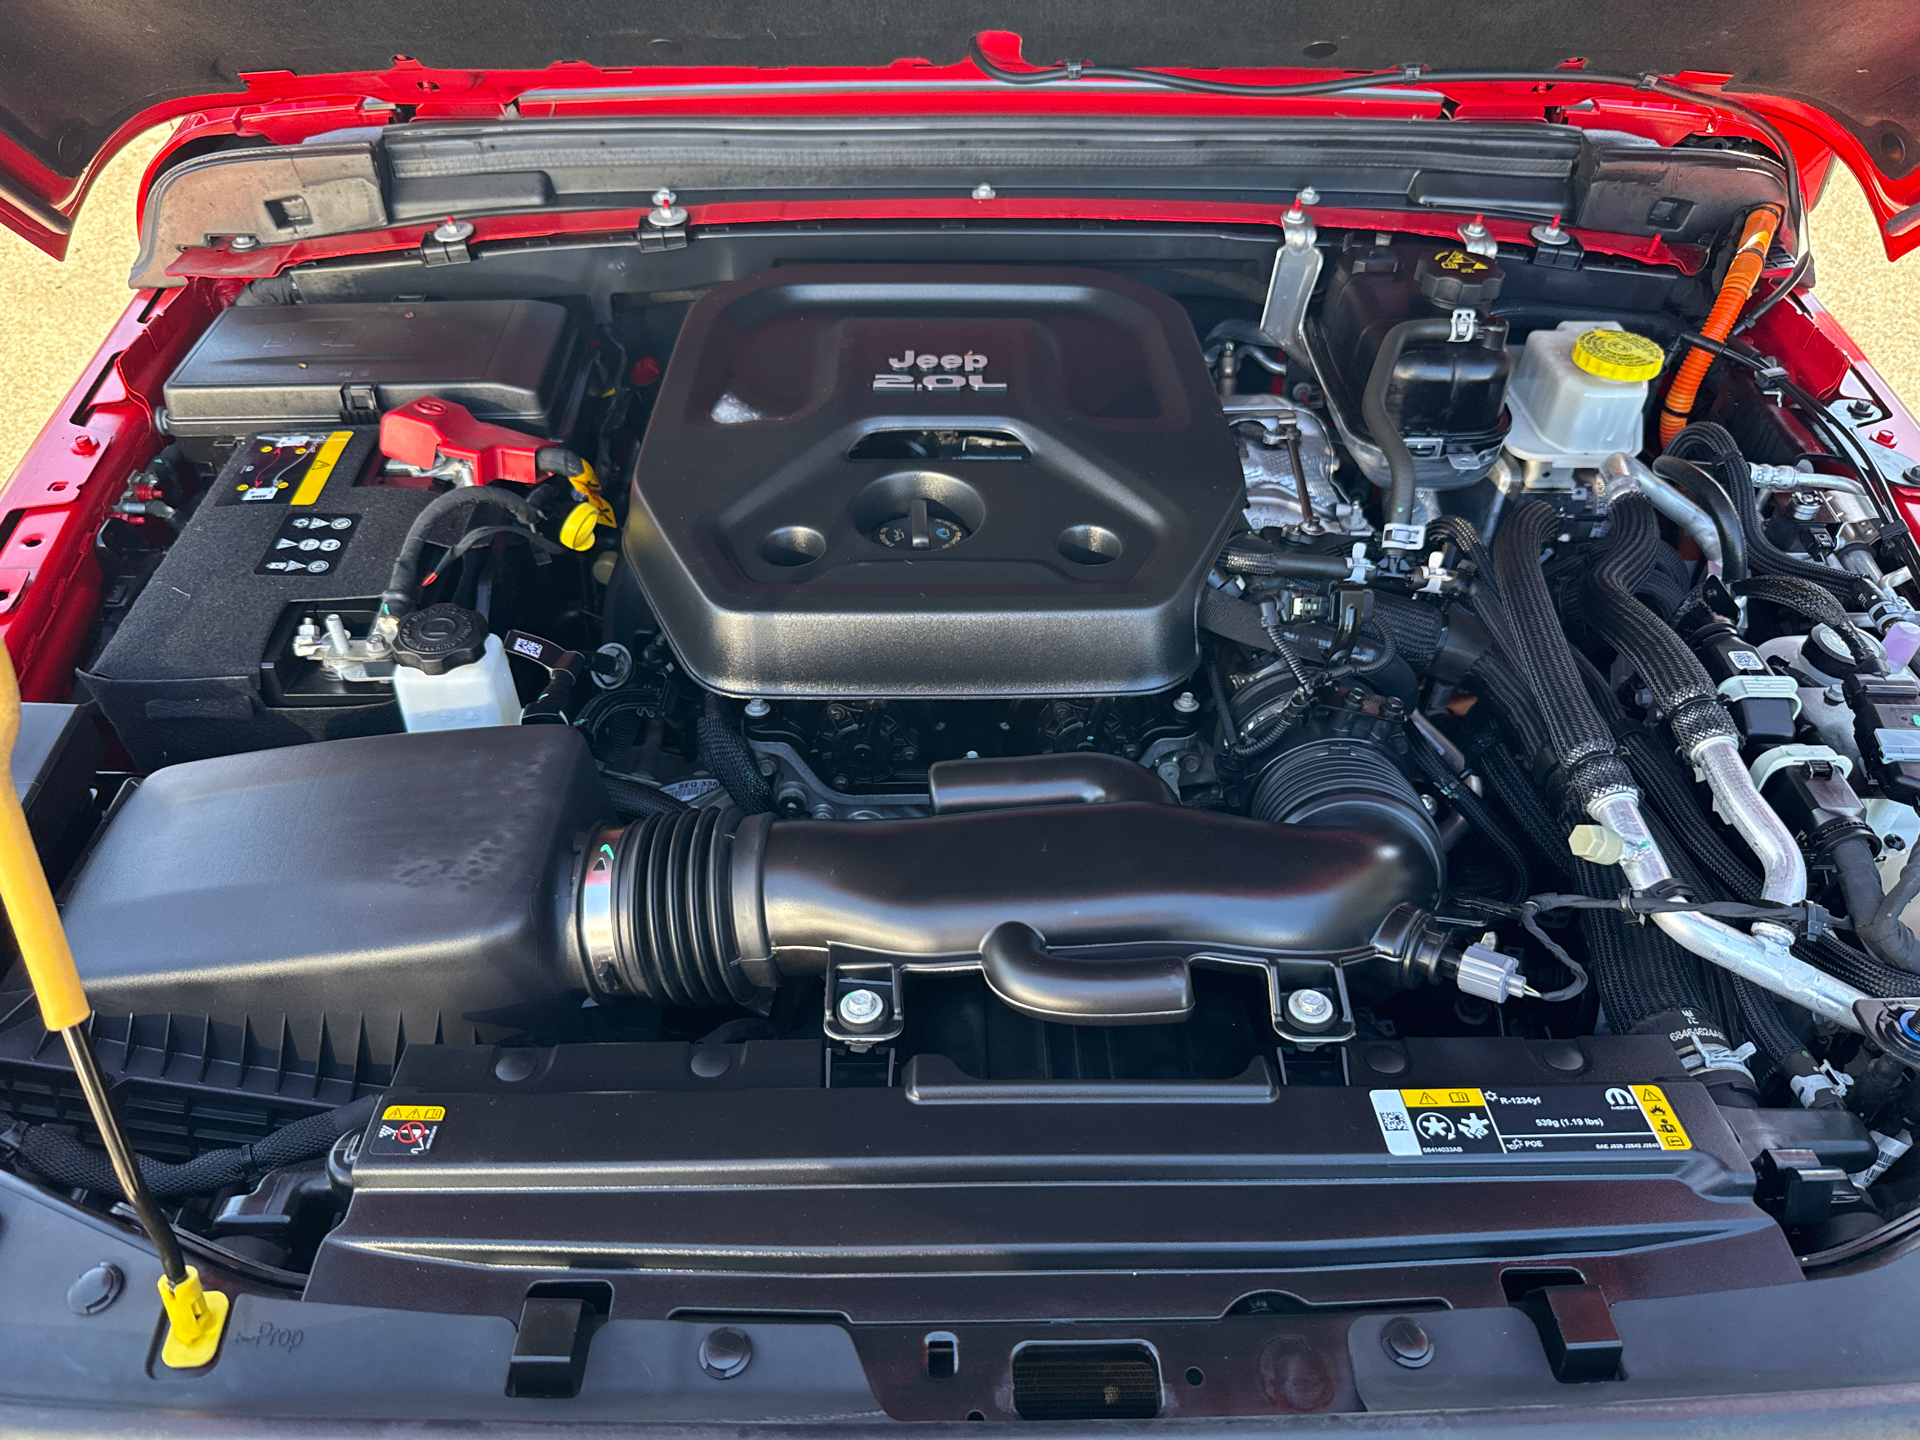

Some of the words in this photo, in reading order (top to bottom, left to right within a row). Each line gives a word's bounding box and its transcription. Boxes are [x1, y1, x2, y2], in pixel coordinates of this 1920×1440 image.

[888, 350, 988, 372] Jeep
[873, 374, 1007, 391] 2.0L
[1500, 1096, 1541, 1106] R-1234yf
[1535, 1118, 1560, 1128] 539g
[1561, 1118, 1583, 1127] (1.19
[1584, 1117, 1604, 1127] lbs)
[1523, 1140, 1544, 1148] POE
[255, 1321, 304, 1355] Prop
